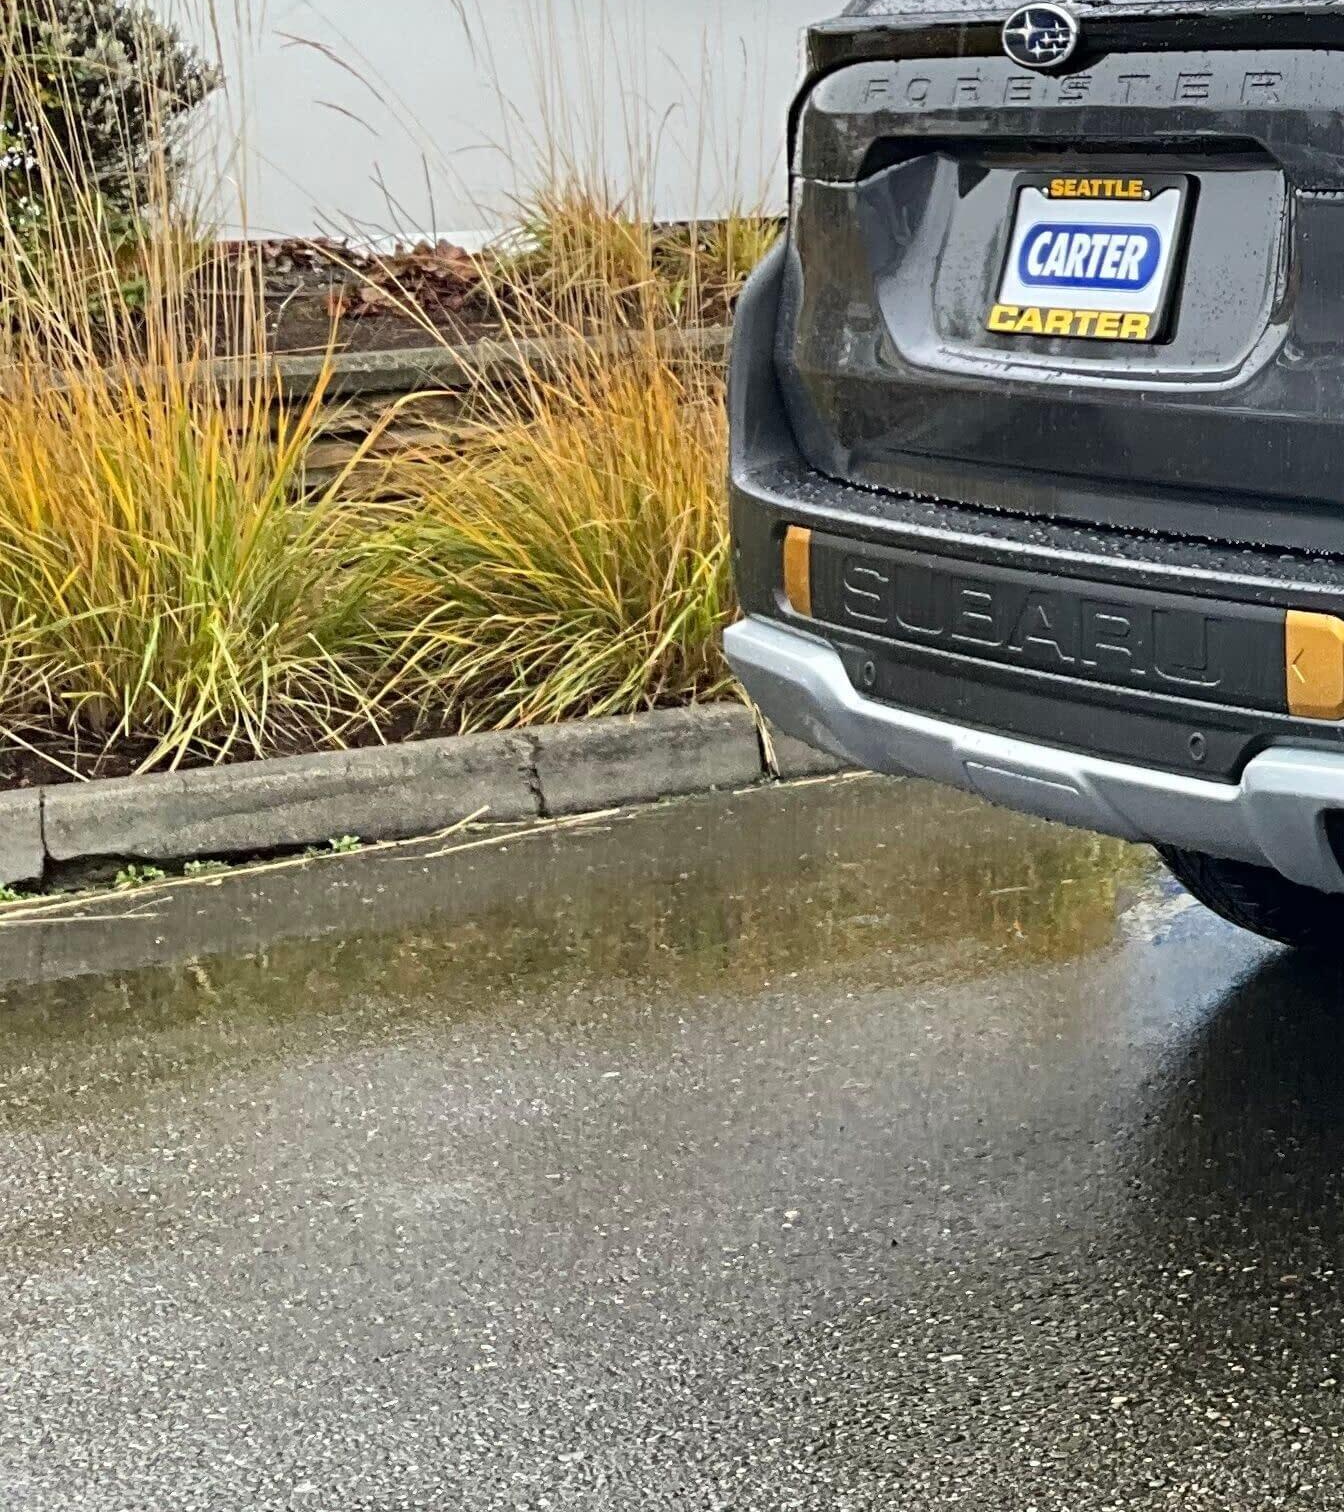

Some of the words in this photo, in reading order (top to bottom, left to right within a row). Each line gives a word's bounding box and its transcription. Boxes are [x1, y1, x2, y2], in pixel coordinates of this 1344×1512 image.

[863, 72, 1283, 106] FORESTER
[1049, 178, 1144, 198] SEATTLE
[1027, 230, 1149, 281] CARTER
[987, 304, 1151, 340] CARTER
[843, 555, 1221, 687] SUBARU
